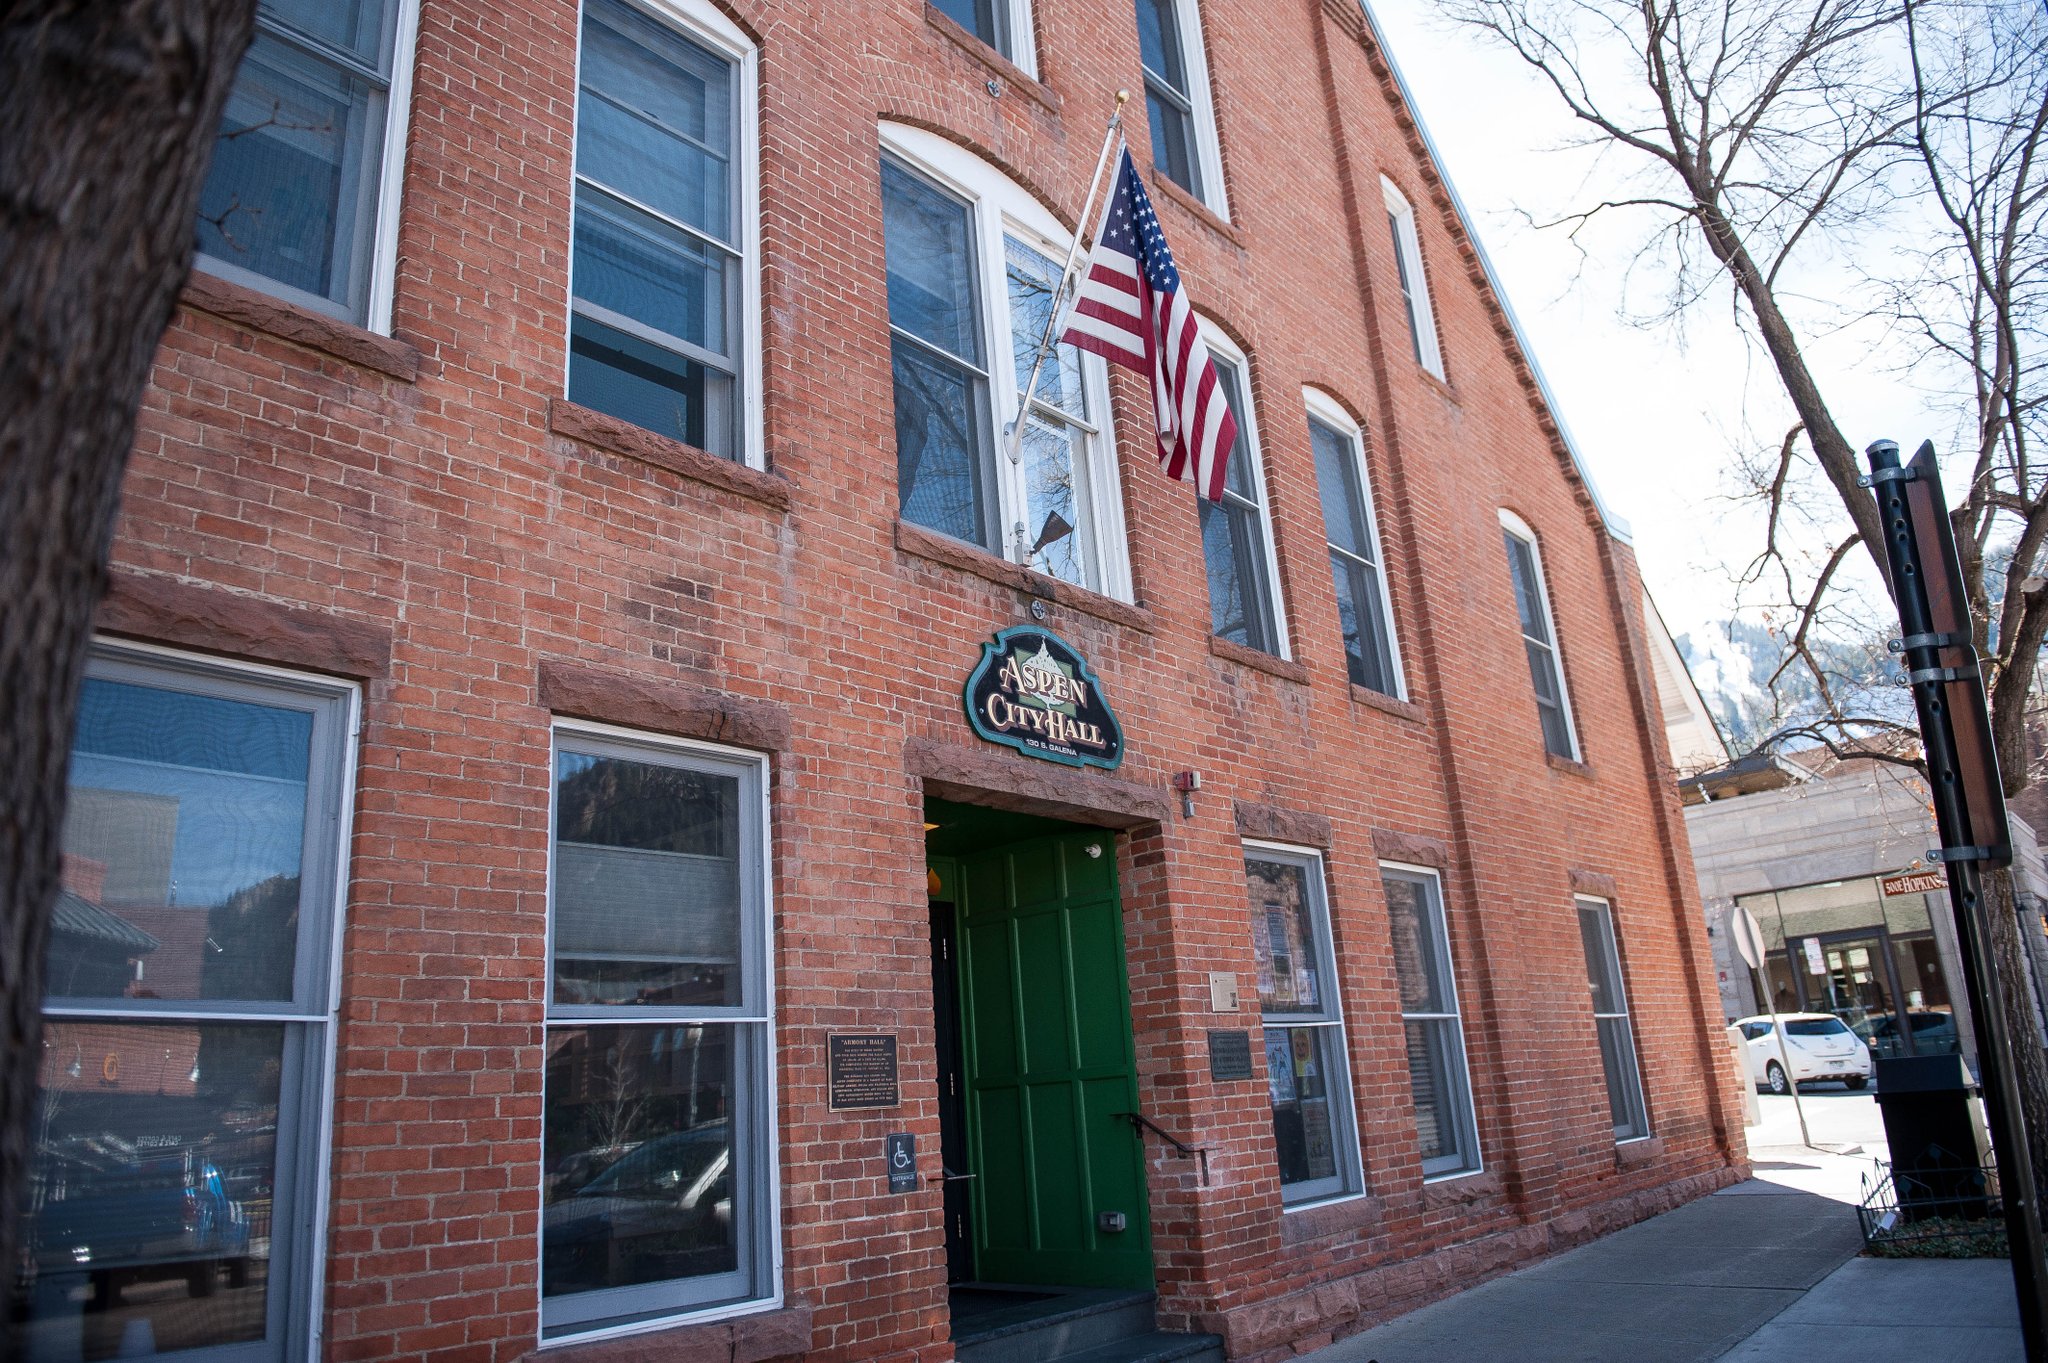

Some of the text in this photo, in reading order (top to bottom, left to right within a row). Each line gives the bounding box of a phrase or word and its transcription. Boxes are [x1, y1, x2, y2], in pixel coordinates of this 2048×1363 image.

[999, 656, 1087, 707] ASPEN
[987, 693, 1106, 746] CITY HALL
[1026, 738, 1078, 756] 130 S. GALENA
[1902, 874, 1941, 893] HOPKINS
